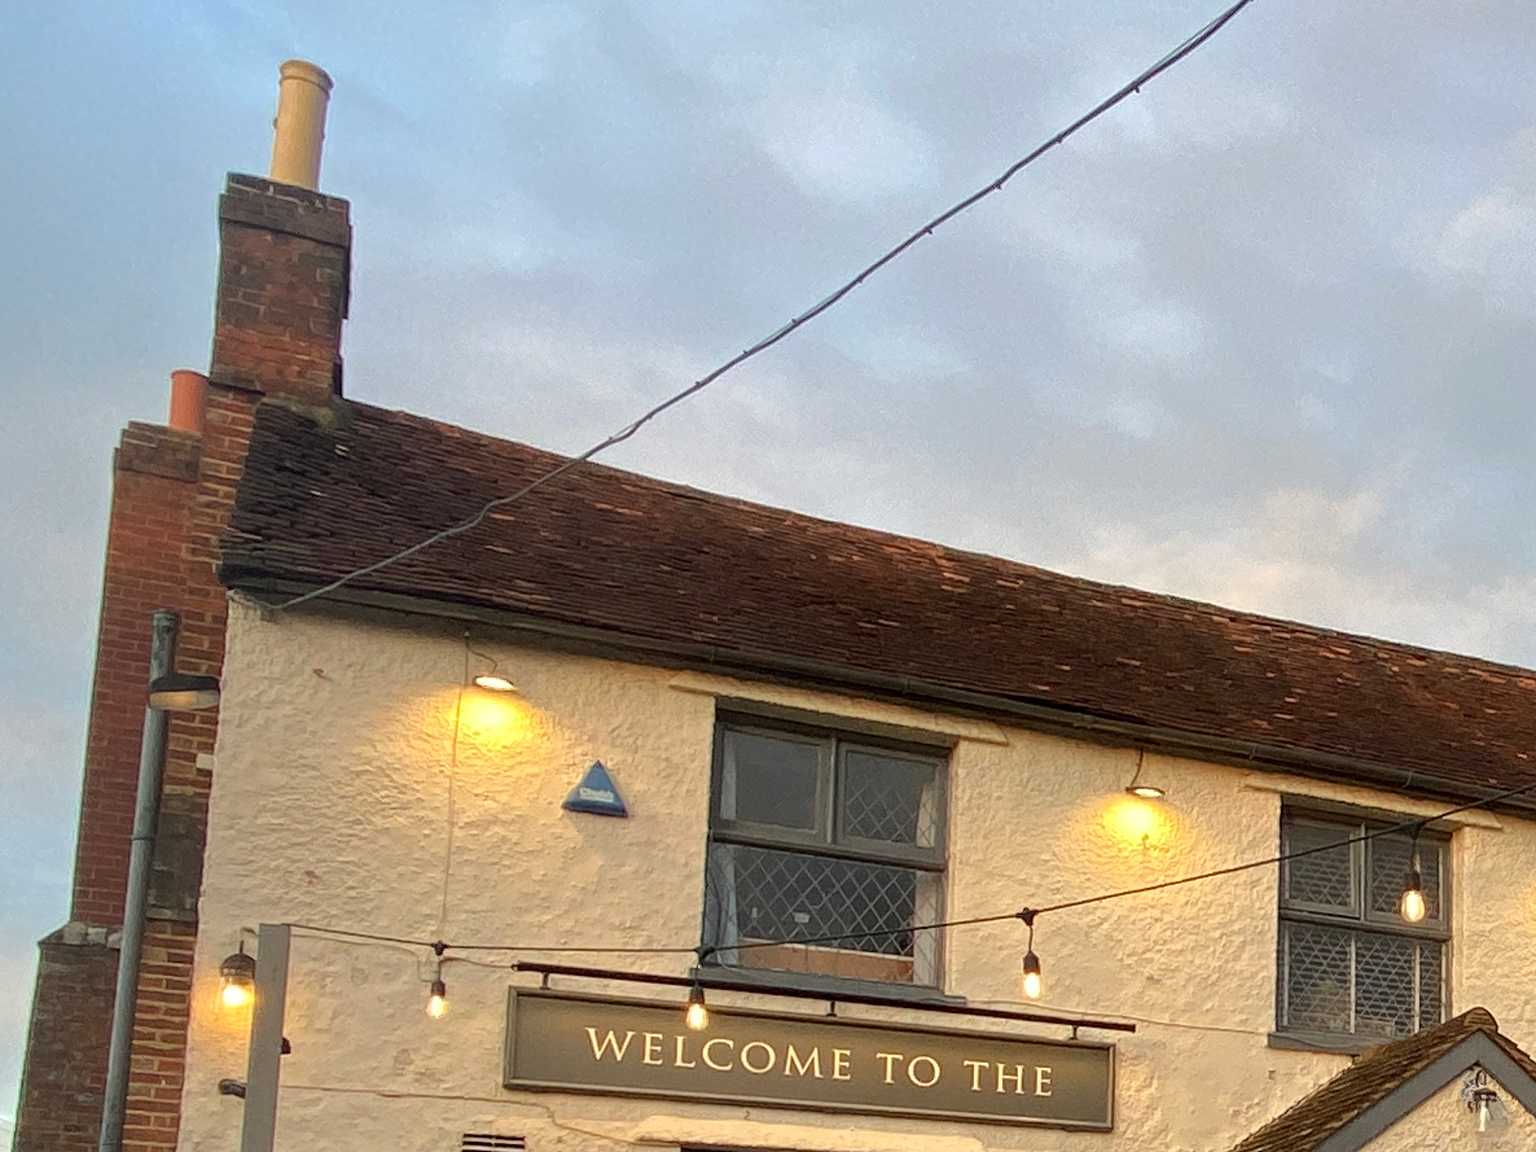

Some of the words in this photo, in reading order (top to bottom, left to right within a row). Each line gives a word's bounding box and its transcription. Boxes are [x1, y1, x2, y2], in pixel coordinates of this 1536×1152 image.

[585, 1026, 852, 1080] WELCOME
[875, 1052, 941, 1088] TO
[963, 1060, 1053, 1097] THE
